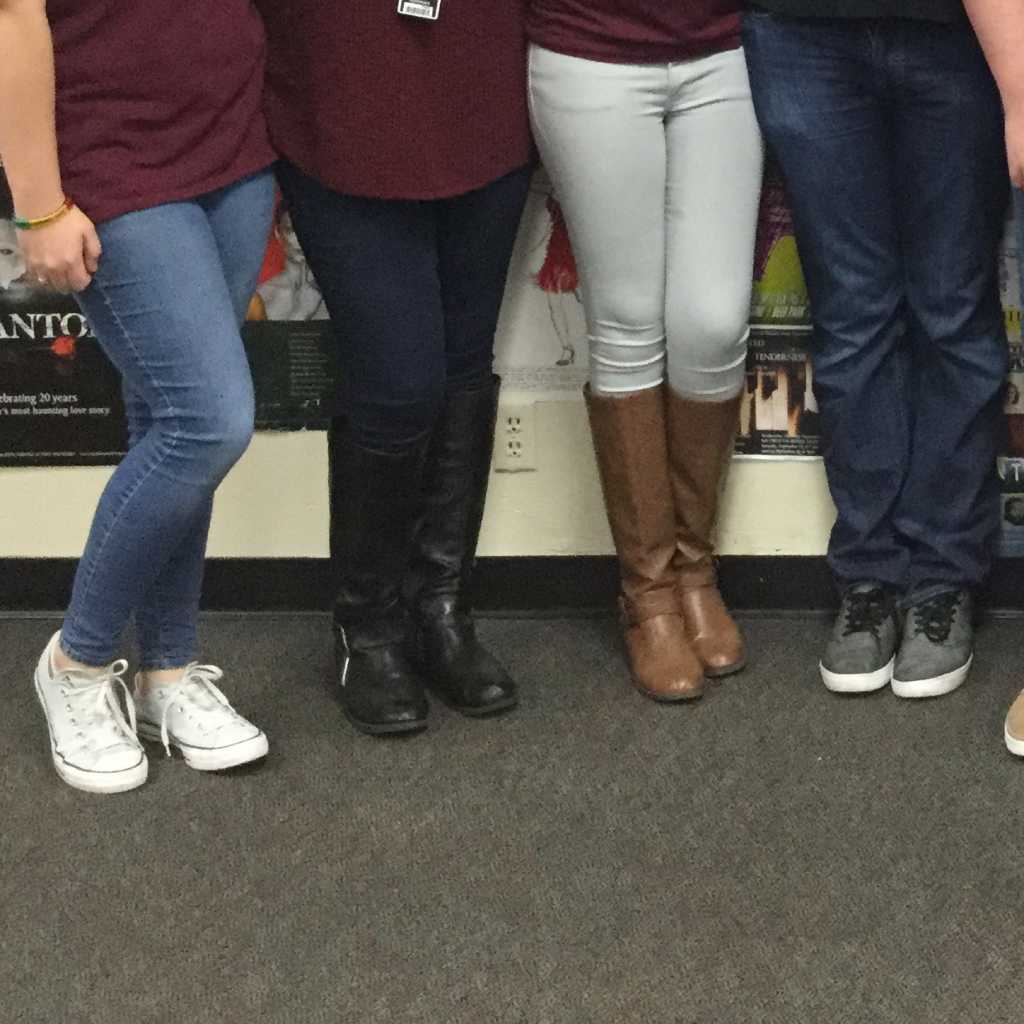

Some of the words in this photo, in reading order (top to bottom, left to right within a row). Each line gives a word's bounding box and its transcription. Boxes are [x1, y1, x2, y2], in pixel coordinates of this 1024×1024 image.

[0, 392, 37, 405] ebrating
[39, 392, 51, 403] 20
[52, 393, 78, 404] years
